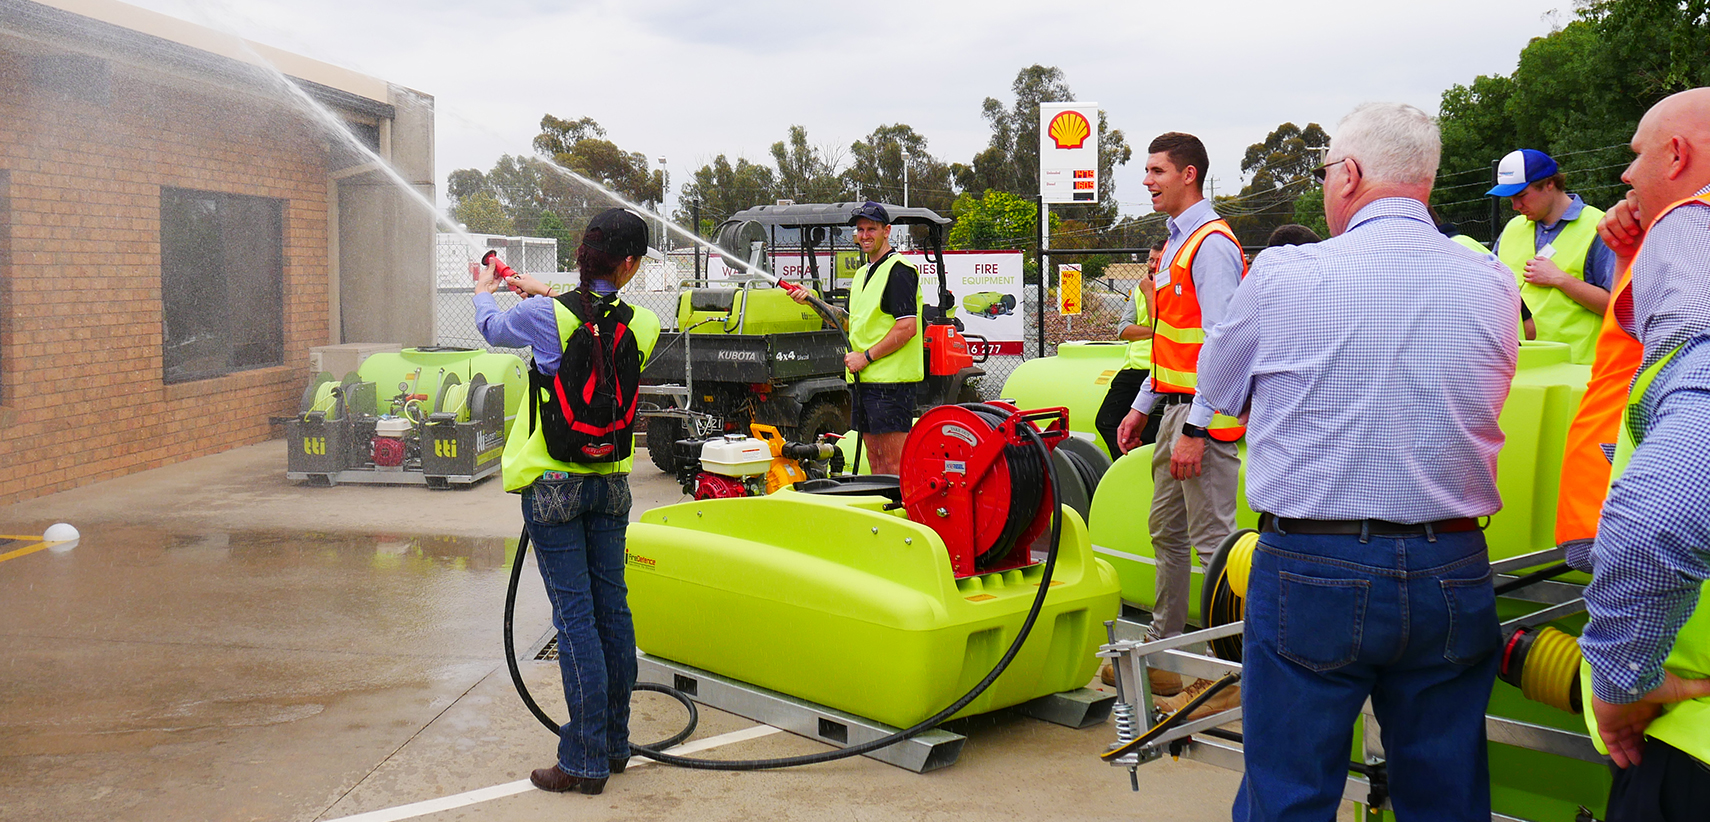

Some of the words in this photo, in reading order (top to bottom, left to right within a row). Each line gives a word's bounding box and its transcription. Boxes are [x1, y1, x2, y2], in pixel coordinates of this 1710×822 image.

[975, 264, 999, 274] FIRE
[962, 276, 1015, 285] EQUIPMENT
[717, 350, 756, 361] KUBOTA
[775, 350, 796, 362] 4x4
[303, 437, 326, 455] tti
[434, 438, 457, 458] tti
